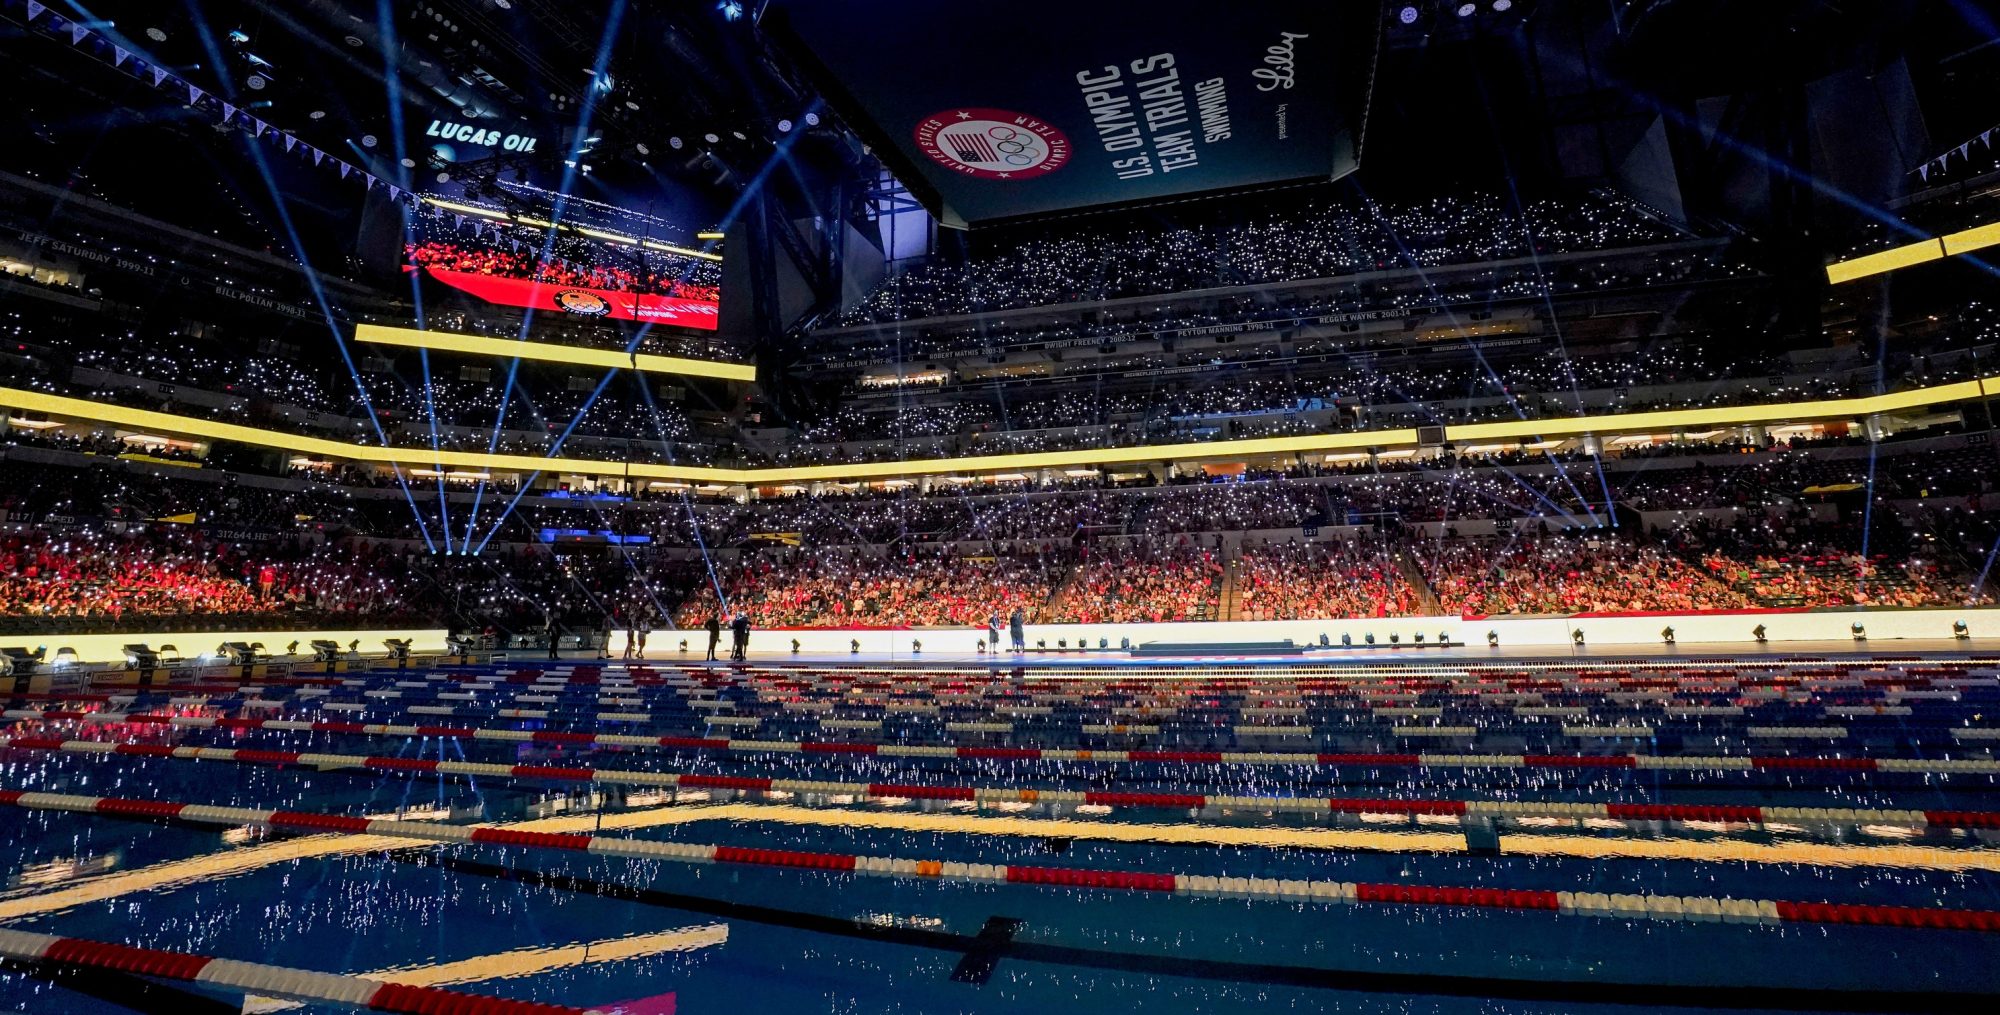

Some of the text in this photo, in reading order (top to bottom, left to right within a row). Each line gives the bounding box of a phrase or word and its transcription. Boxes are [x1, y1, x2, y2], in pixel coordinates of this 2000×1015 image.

[1252, 31, 1309, 91] Lilly
[1076, 65, 1154, 179] U.S. OLYMPIC
[1130, 52, 1198, 173] TEAM TRIALS
[1194, 77, 1232, 144] SWIMMING
[426, 120, 537, 152] LUCAS OIL
[919, 119, 975, 173] UNITED STATES
[1014, 116, 1067, 171] OLYMPIC TEAM
[18, 232, 155, 276] JEFF SATURDAY 1999-11
[215, 286, 237, 299] BILL
[240, 293, 273, 308] POLIAN
[1178, 328, 1208, 337] PEYTON
[1209, 325, 1243, 334] MANNING
[1320, 315, 1349, 324] REGGIE
[1350, 312, 1377, 321] WAYNE
[930, 352, 953, 360] ROBERT
[954, 349, 978, 358] MATHIS
[1044, 341, 1072, 349] DWIGHT
[9, 512, 29, 521] 117
[1304, 528, 1317, 536] 127
